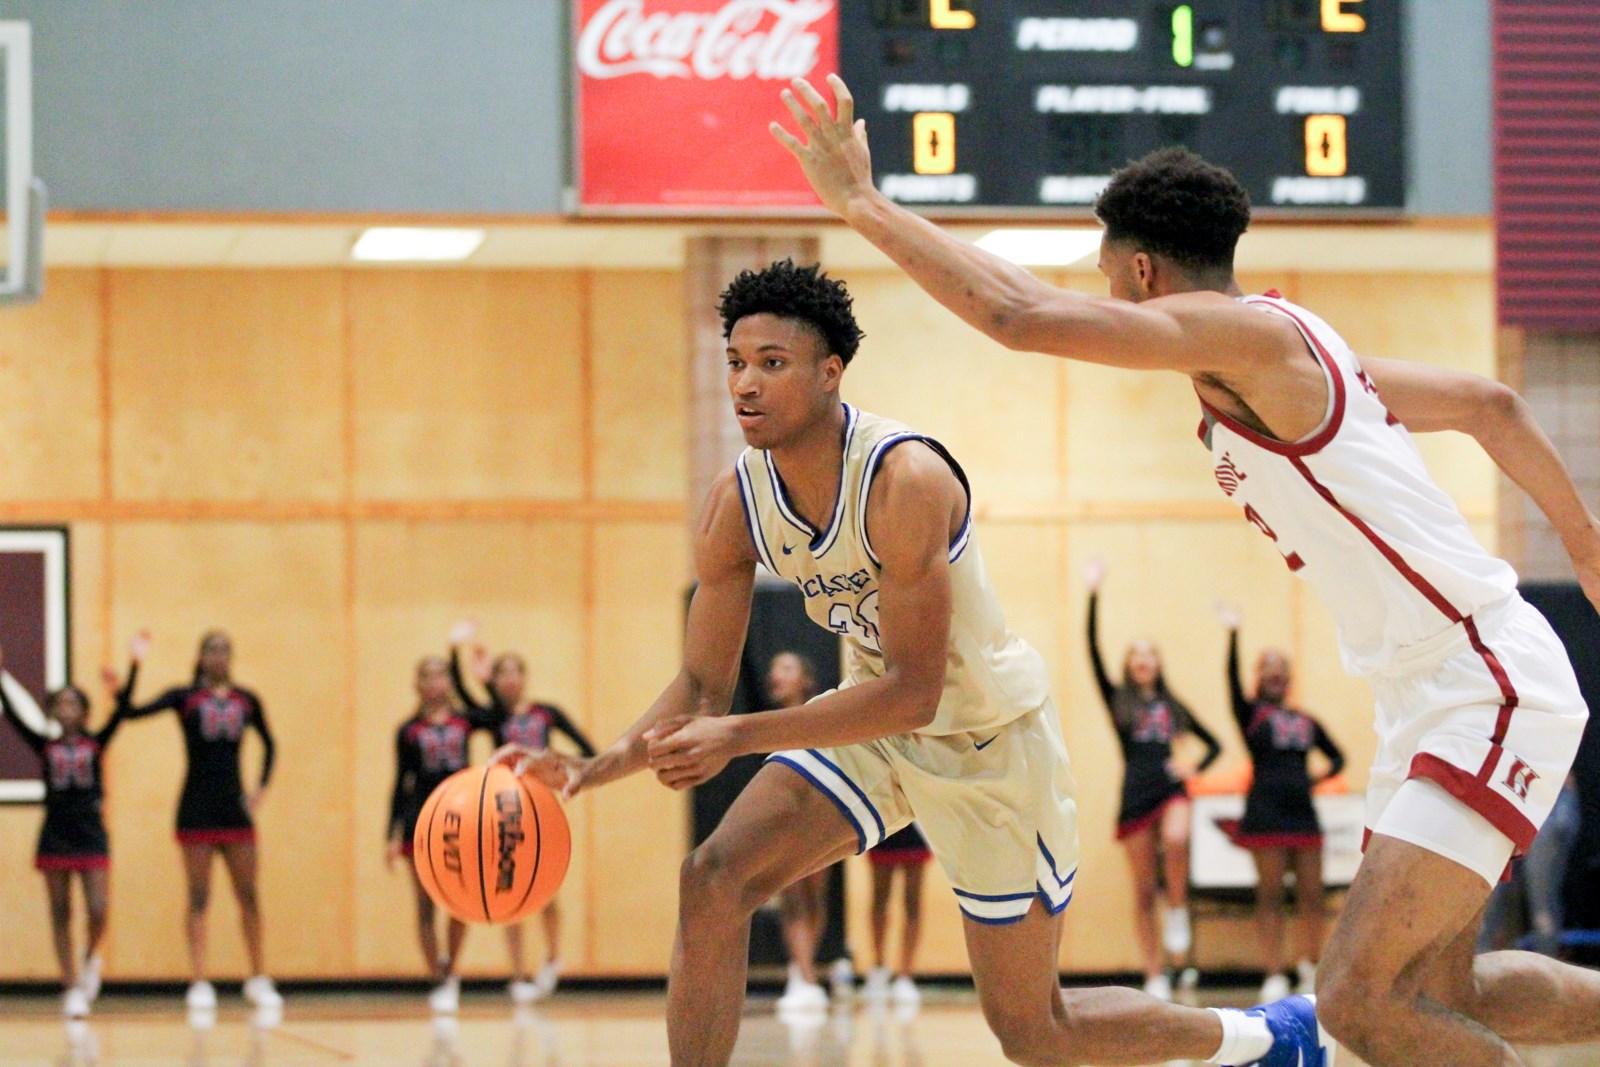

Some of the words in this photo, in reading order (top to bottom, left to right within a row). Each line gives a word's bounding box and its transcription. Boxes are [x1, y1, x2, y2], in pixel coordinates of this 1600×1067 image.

[1171, 5, 1193, 67] 1
[912, 111, 957, 175] 0
[1304, 113, 1348, 177] 0
